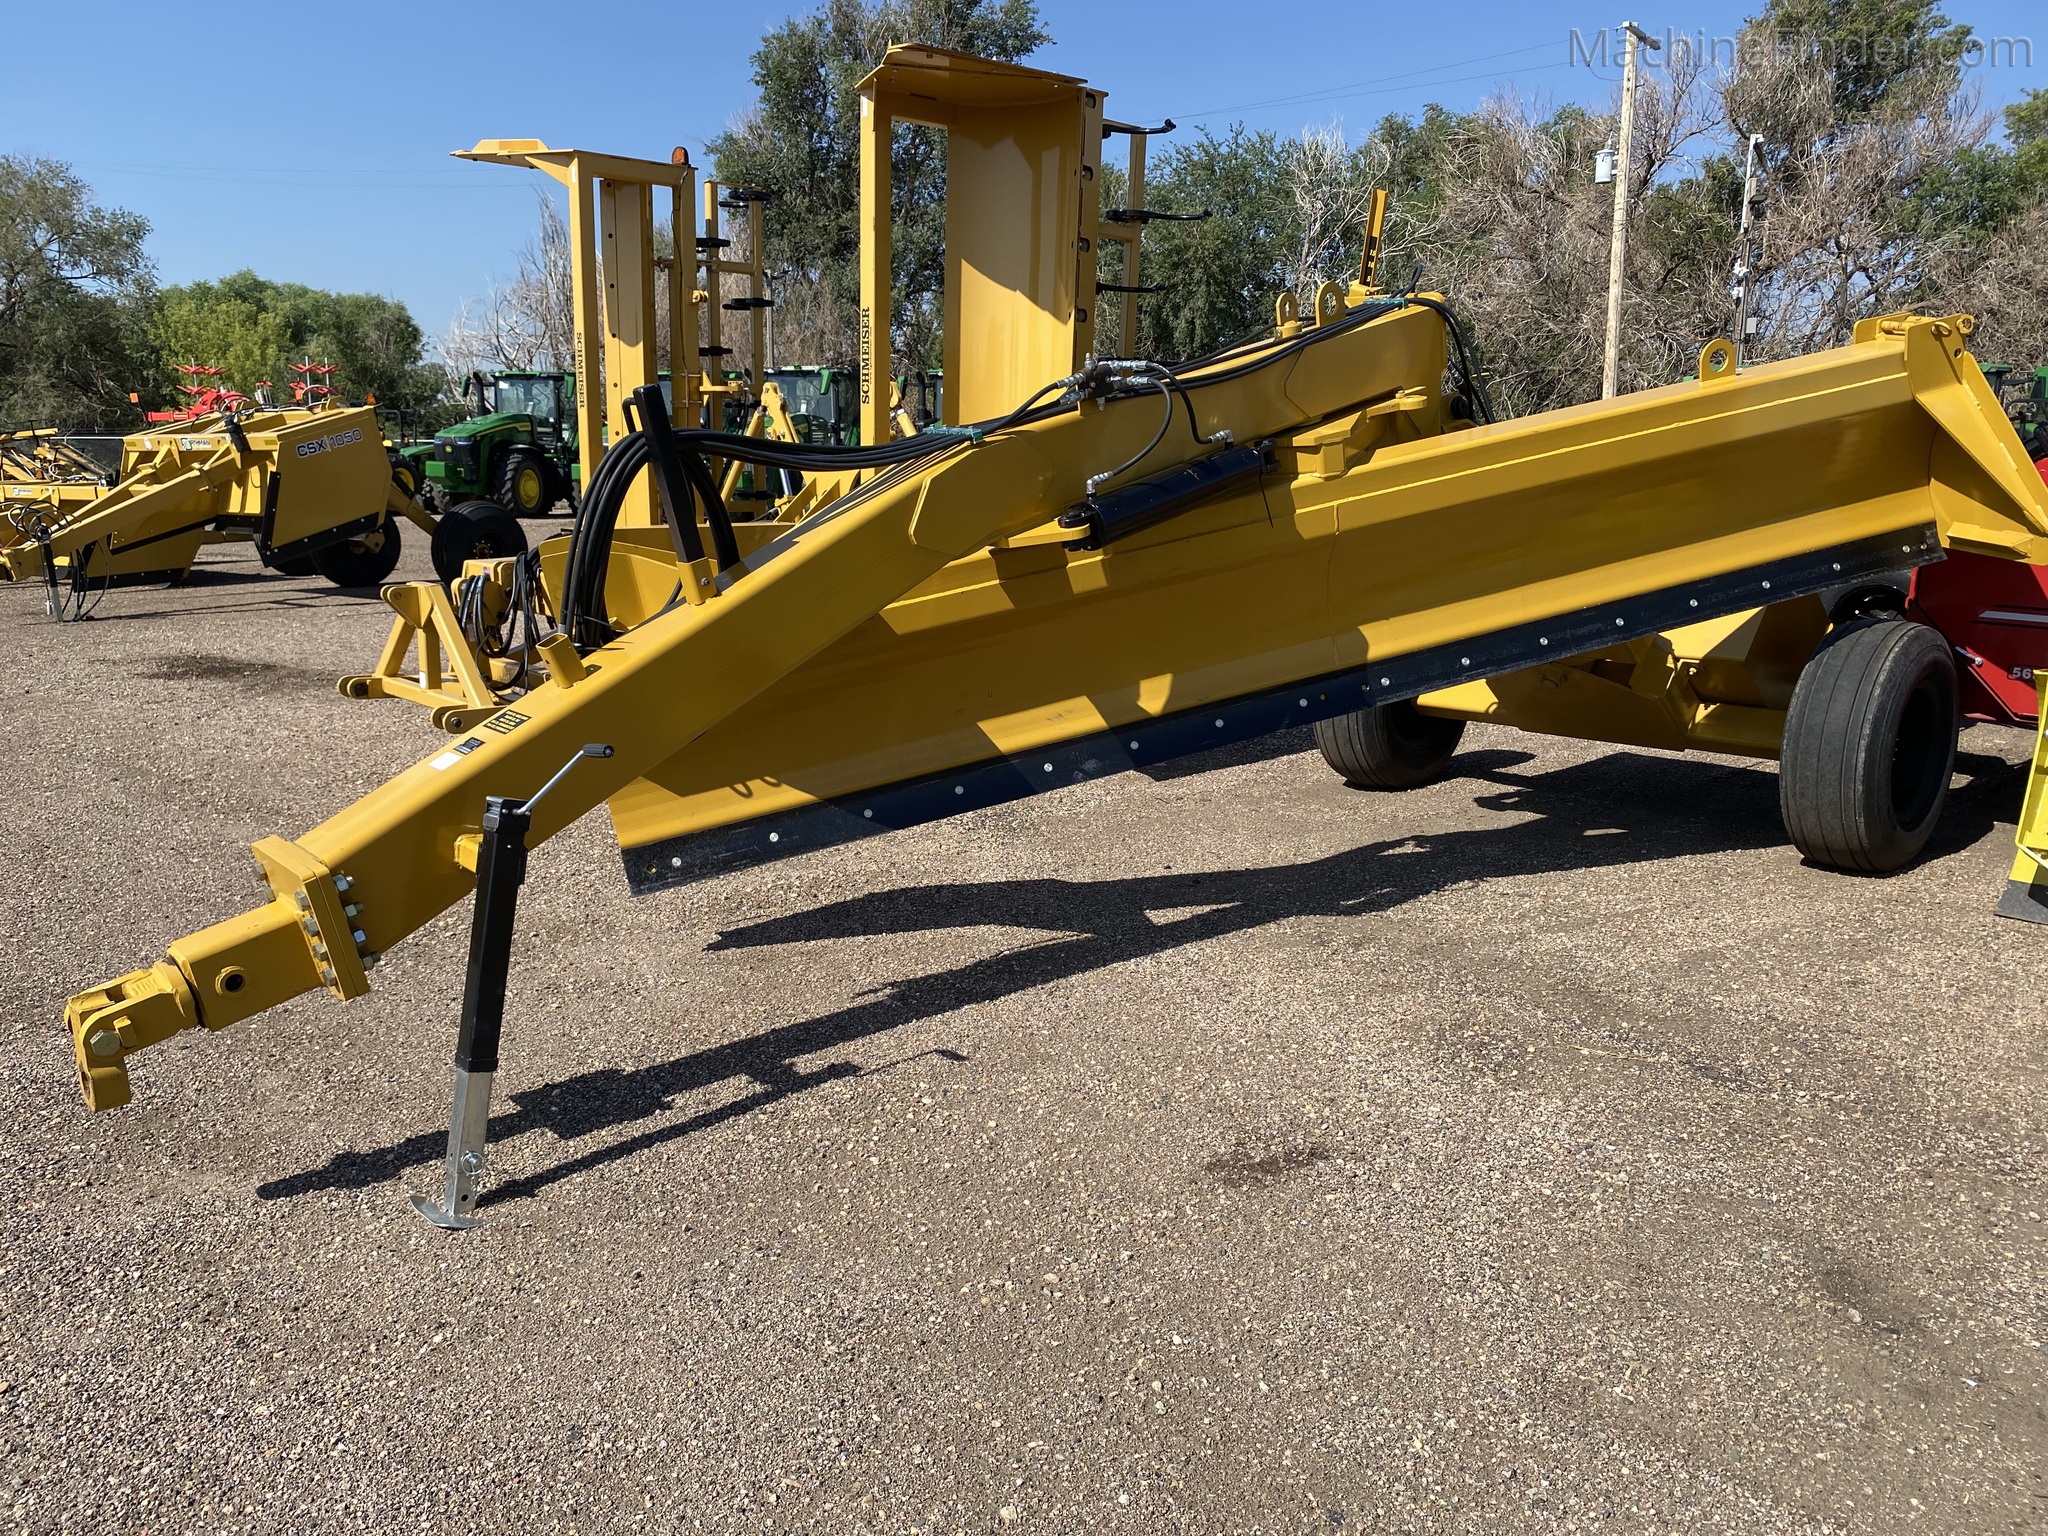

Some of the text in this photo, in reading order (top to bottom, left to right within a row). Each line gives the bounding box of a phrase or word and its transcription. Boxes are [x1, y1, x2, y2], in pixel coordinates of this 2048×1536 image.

[576, 332, 585, 409] SCHMEISER
[862, 306, 870, 404] SCHMEISER
[2012, 666, 2035, 679] 56
